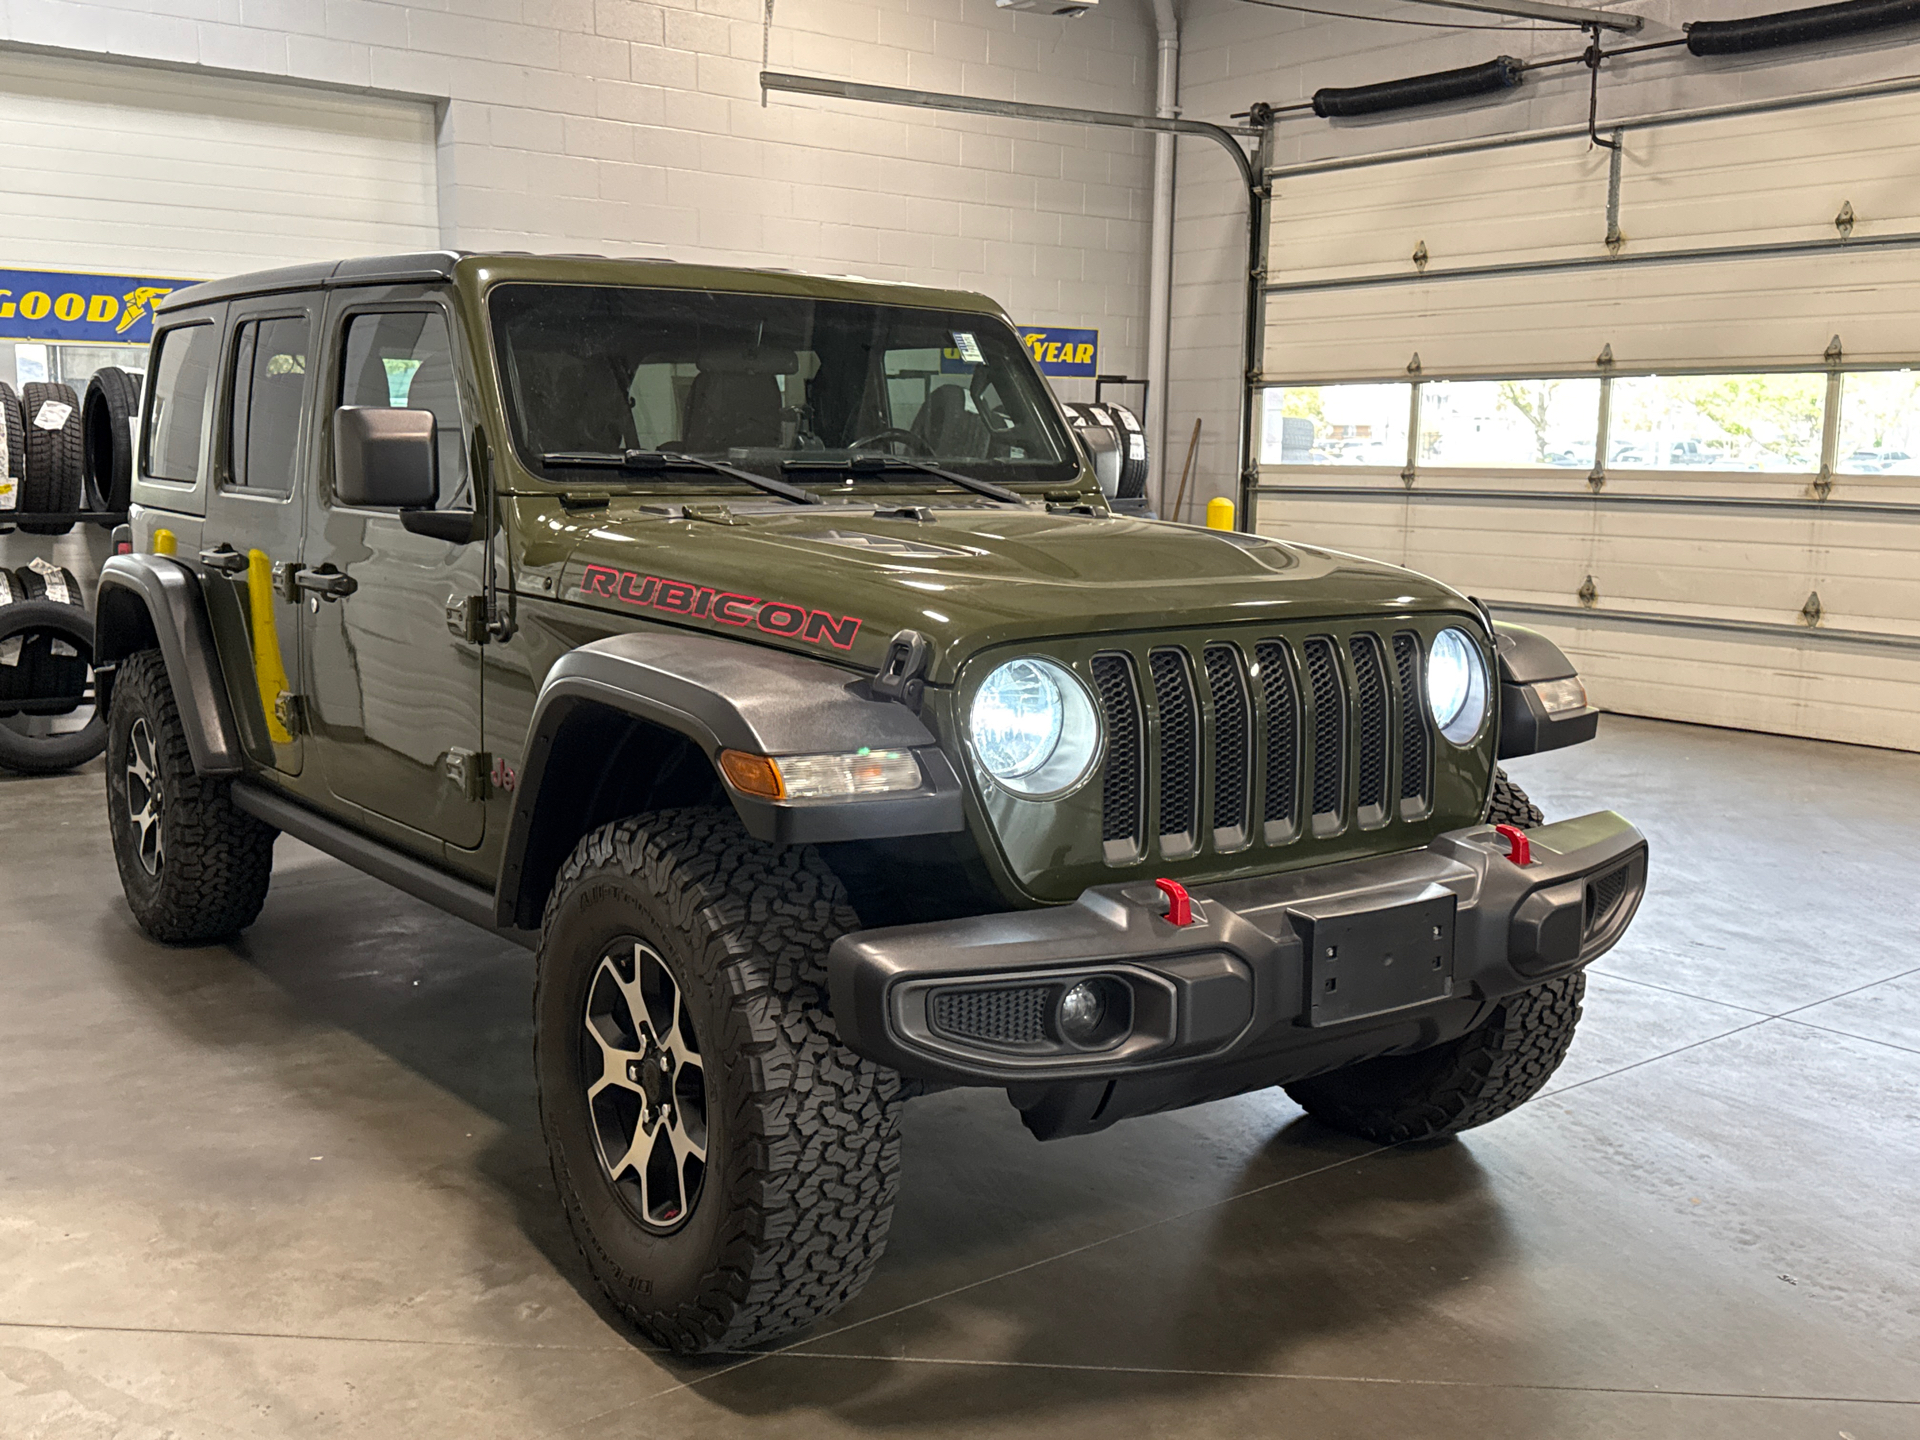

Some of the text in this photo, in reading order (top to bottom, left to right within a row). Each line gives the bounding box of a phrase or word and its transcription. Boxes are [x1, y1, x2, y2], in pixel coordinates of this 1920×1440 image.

[1033, 341, 1094, 364] YEAR
[581, 564, 862, 649] RUBICON
[490, 757, 516, 793] Je
